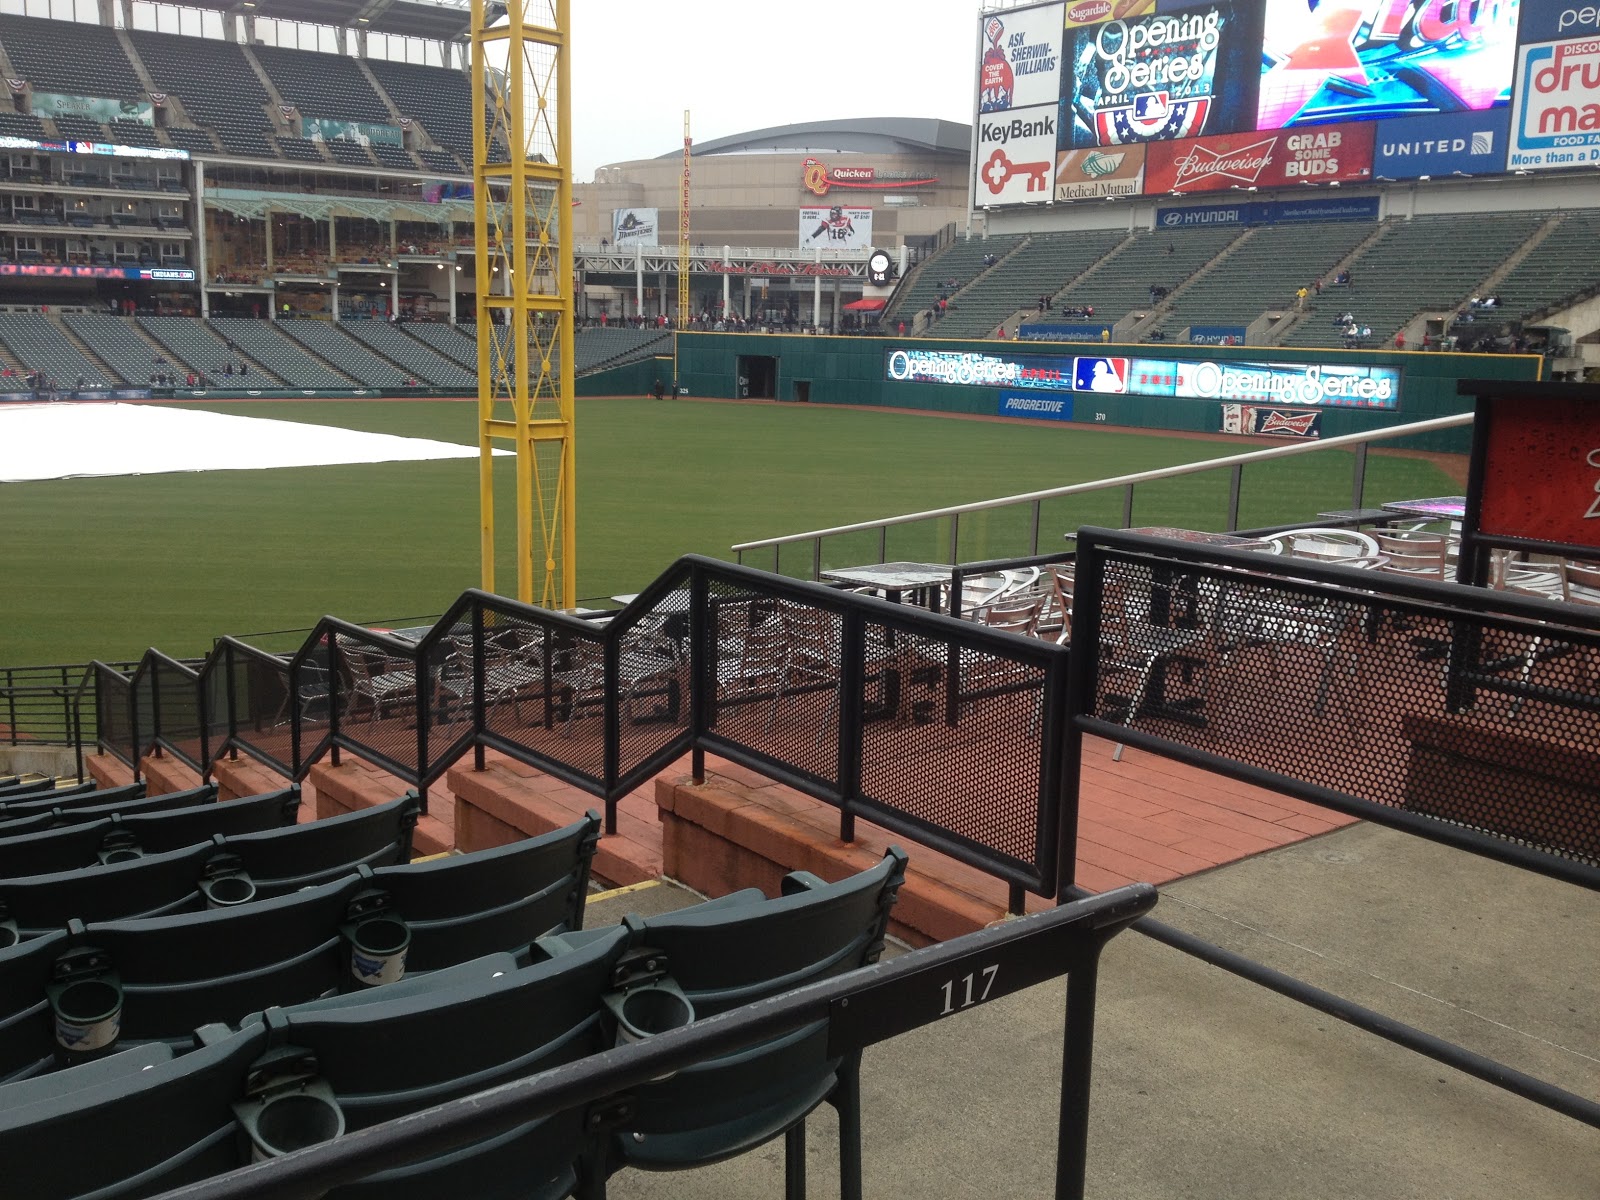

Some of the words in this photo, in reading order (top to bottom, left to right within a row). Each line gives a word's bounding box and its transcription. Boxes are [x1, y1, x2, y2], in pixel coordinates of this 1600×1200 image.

[1069, 3, 1111, 20] Sugardale
[1558, 7, 1600, 32] pe
[1008, 32, 1026, 48] ASK
[1096, 10, 1219, 60] Opening
[1011, 43, 1052, 62] SHERWIN-
[1564, 42, 1600, 55] DISCO
[985, 63, 1004, 72] COVER
[1015, 56, 1056, 76] WILLIAMS
[1105, 52, 1204, 94] Series
[985, 77, 1003, 85] EARTH
[1098, 94, 1129, 106] APRIL
[1175, 83, 1210, 96] 2013
[57, 100, 91, 110] SPEAKER
[1539, 104, 1600, 133] ma
[981, 116, 1054, 144] KeyBank
[1287, 132, 1341, 150] GRAB
[1383, 139, 1465, 156] UNITED
[1554, 136, 1584, 146] FOOD
[1295, 148, 1331, 160] SOME
[1511, 154, 1541, 165] More
[1546, 152, 1573, 163] than
[1578, 153, 1585, 161] a
[1174, 153, 1273, 176] Budweiser
[1285, 159, 1338, 177] BUDS
[833, 169, 873, 178] Quicken
[1060, 186, 1098, 199] Medical
[1100, 181, 1137, 195] Mutual
[1185, 210, 1239, 223] HYUNDAI
[890, 350, 957, 384] Opening
[957, 353, 1015, 384] Series
[1021, 369, 1061, 380] APRIL
[1140, 374, 1184, 386] 2013
[1191, 361, 1296, 403] Opening
[1298, 365, 1391, 404] Series
[1006, 398, 1065, 412] PROGRESSIVE
[1095, 413, 1106, 421] 370
[1263, 415, 1314, 427] Budweiser
[940, 963, 999, 1015] 117
